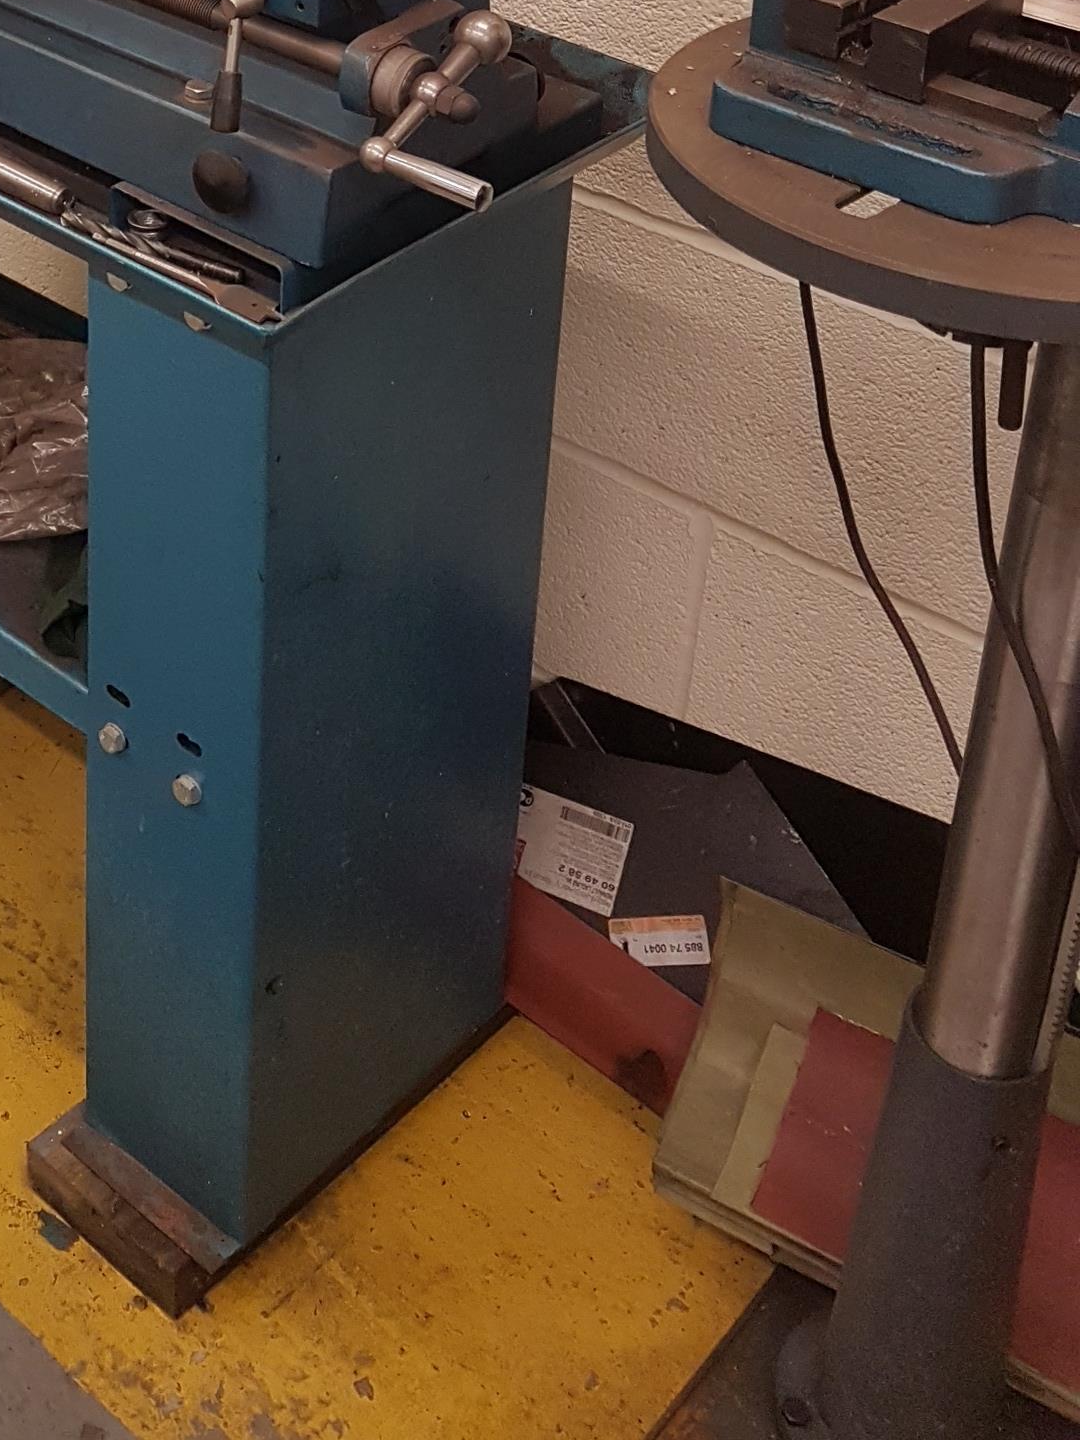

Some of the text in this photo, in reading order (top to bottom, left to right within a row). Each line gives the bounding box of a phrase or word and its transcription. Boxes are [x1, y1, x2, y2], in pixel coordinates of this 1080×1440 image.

[558, 863, 566, 873] 2
[584, 874, 599, 885] 49
[601, 881, 616, 892] 60
[643, 943, 667, 954] 0041
[669, 943, 683, 953] 74
